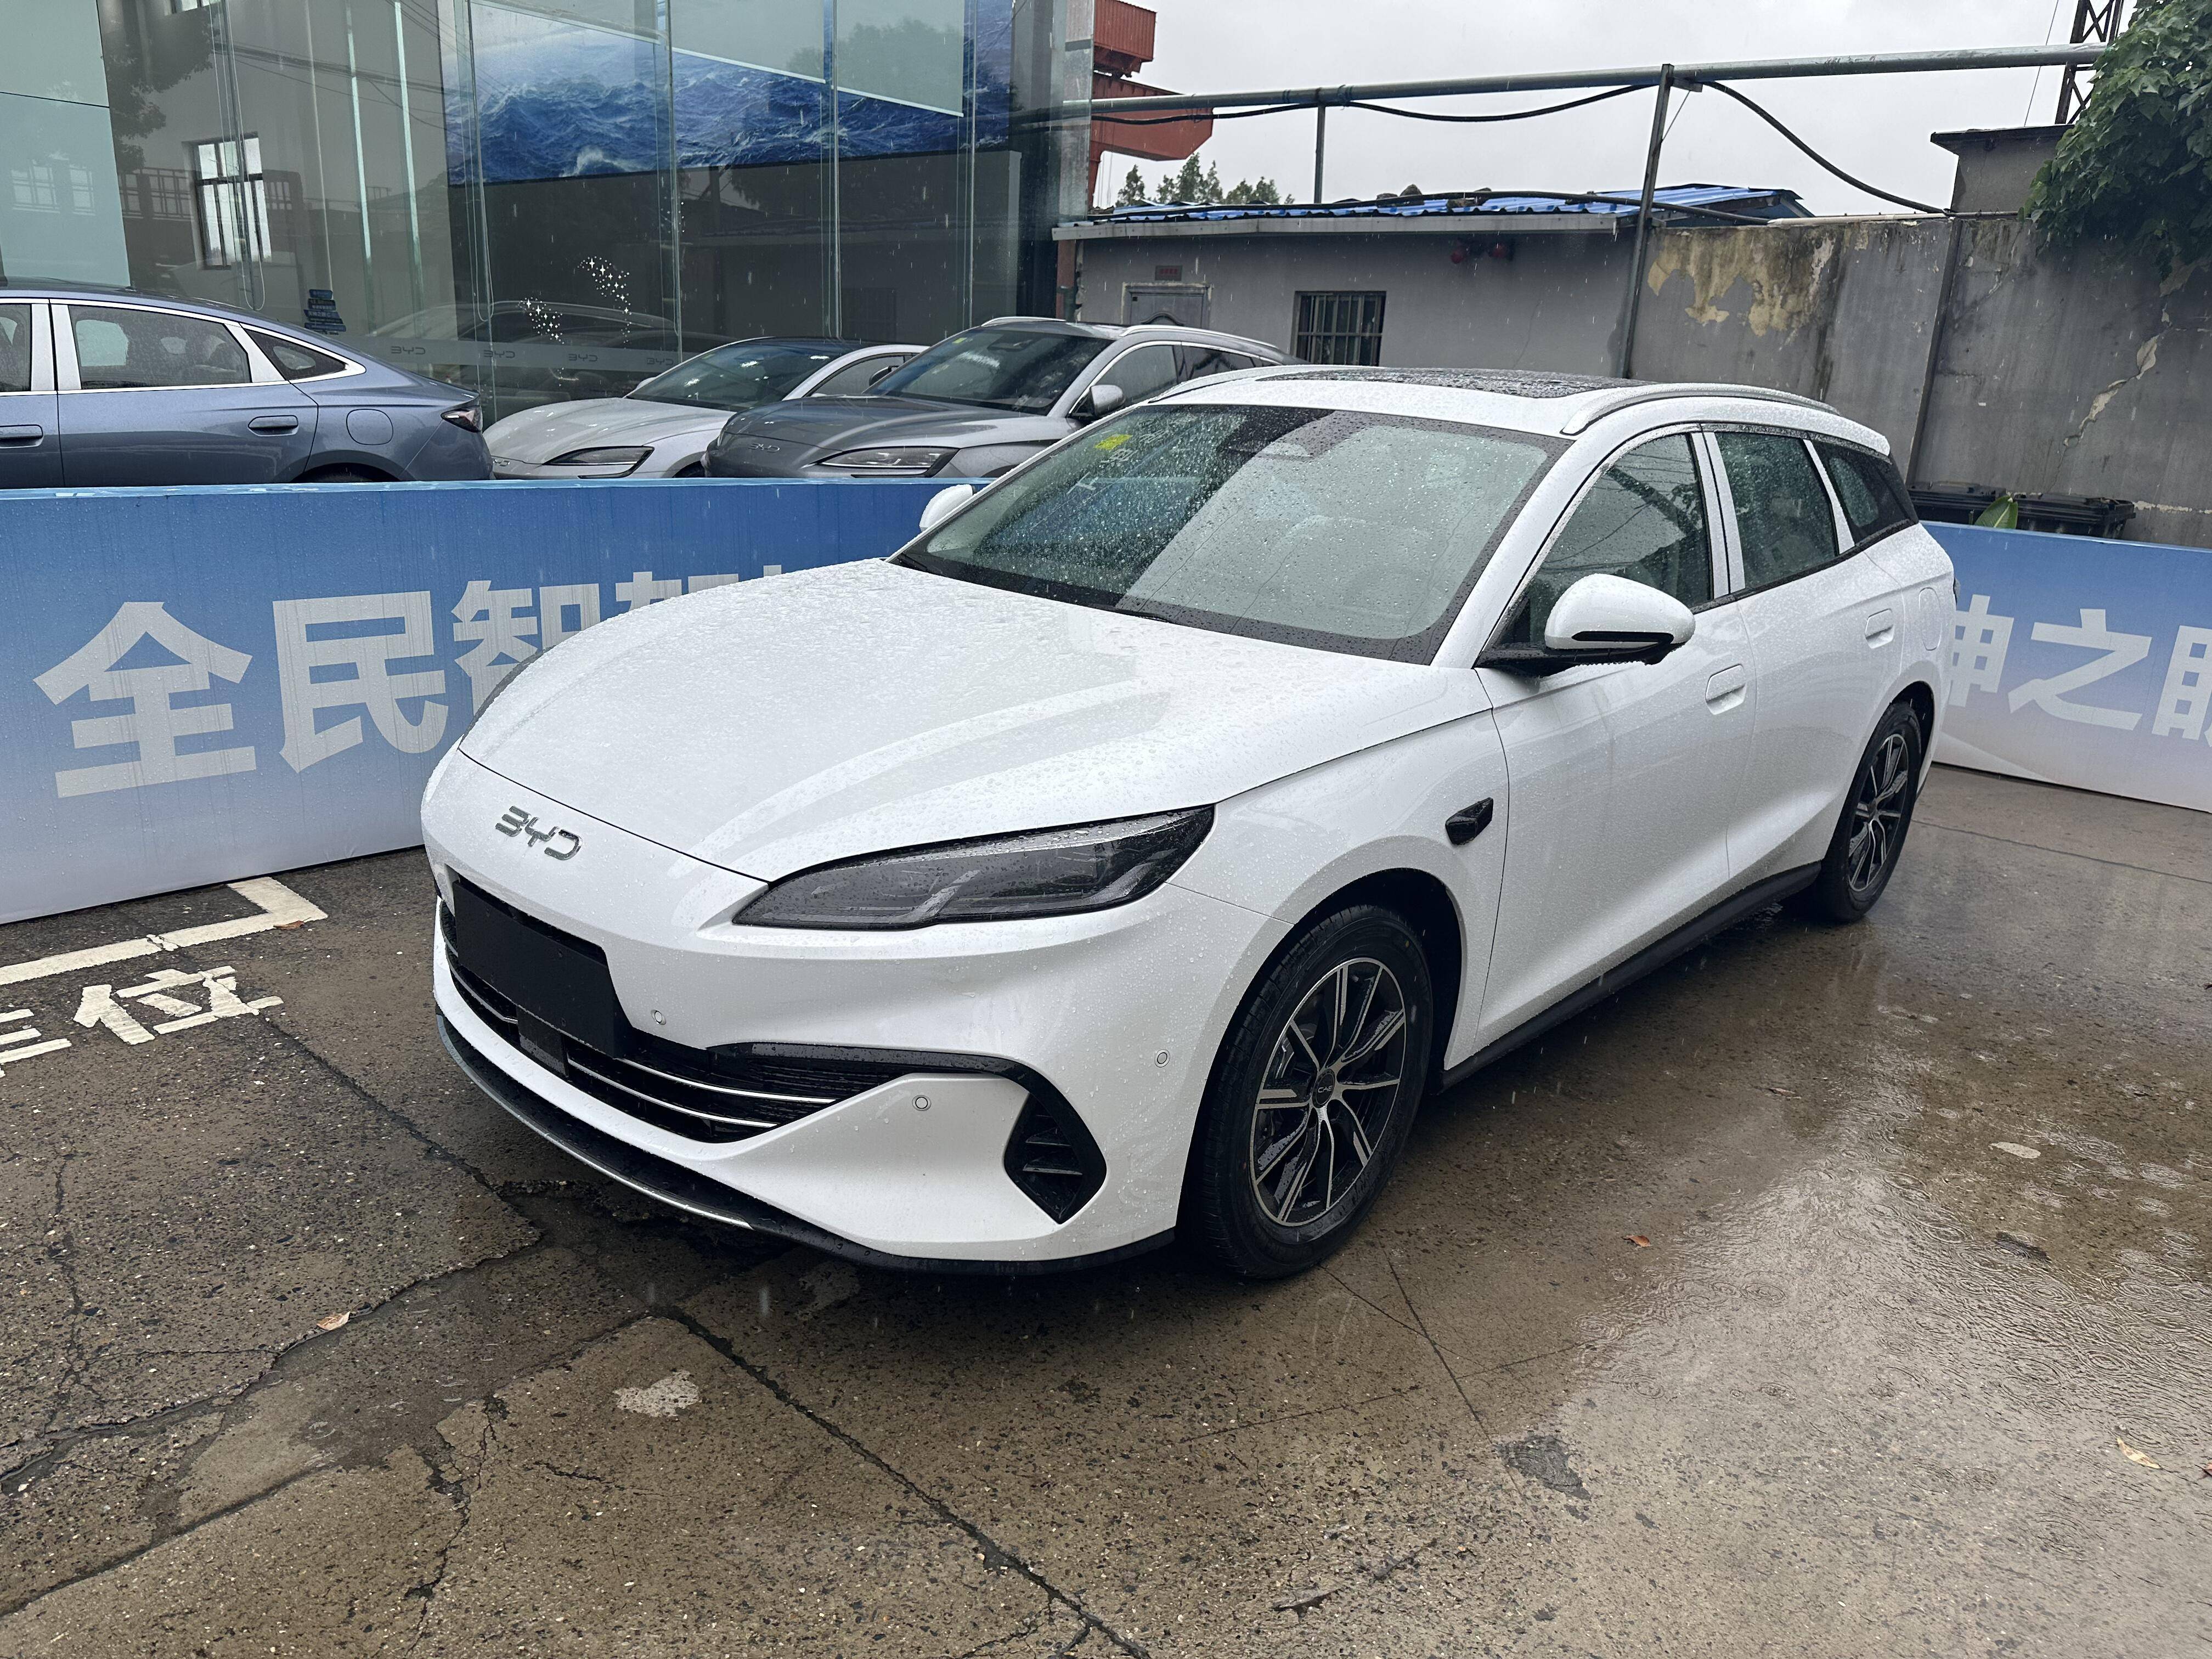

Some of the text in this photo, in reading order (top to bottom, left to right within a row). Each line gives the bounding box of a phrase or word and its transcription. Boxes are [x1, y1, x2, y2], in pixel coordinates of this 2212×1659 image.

[391, 346, 674, 365] BYD BYD BYD BYD
[495, 805, 583, 861] BYD
